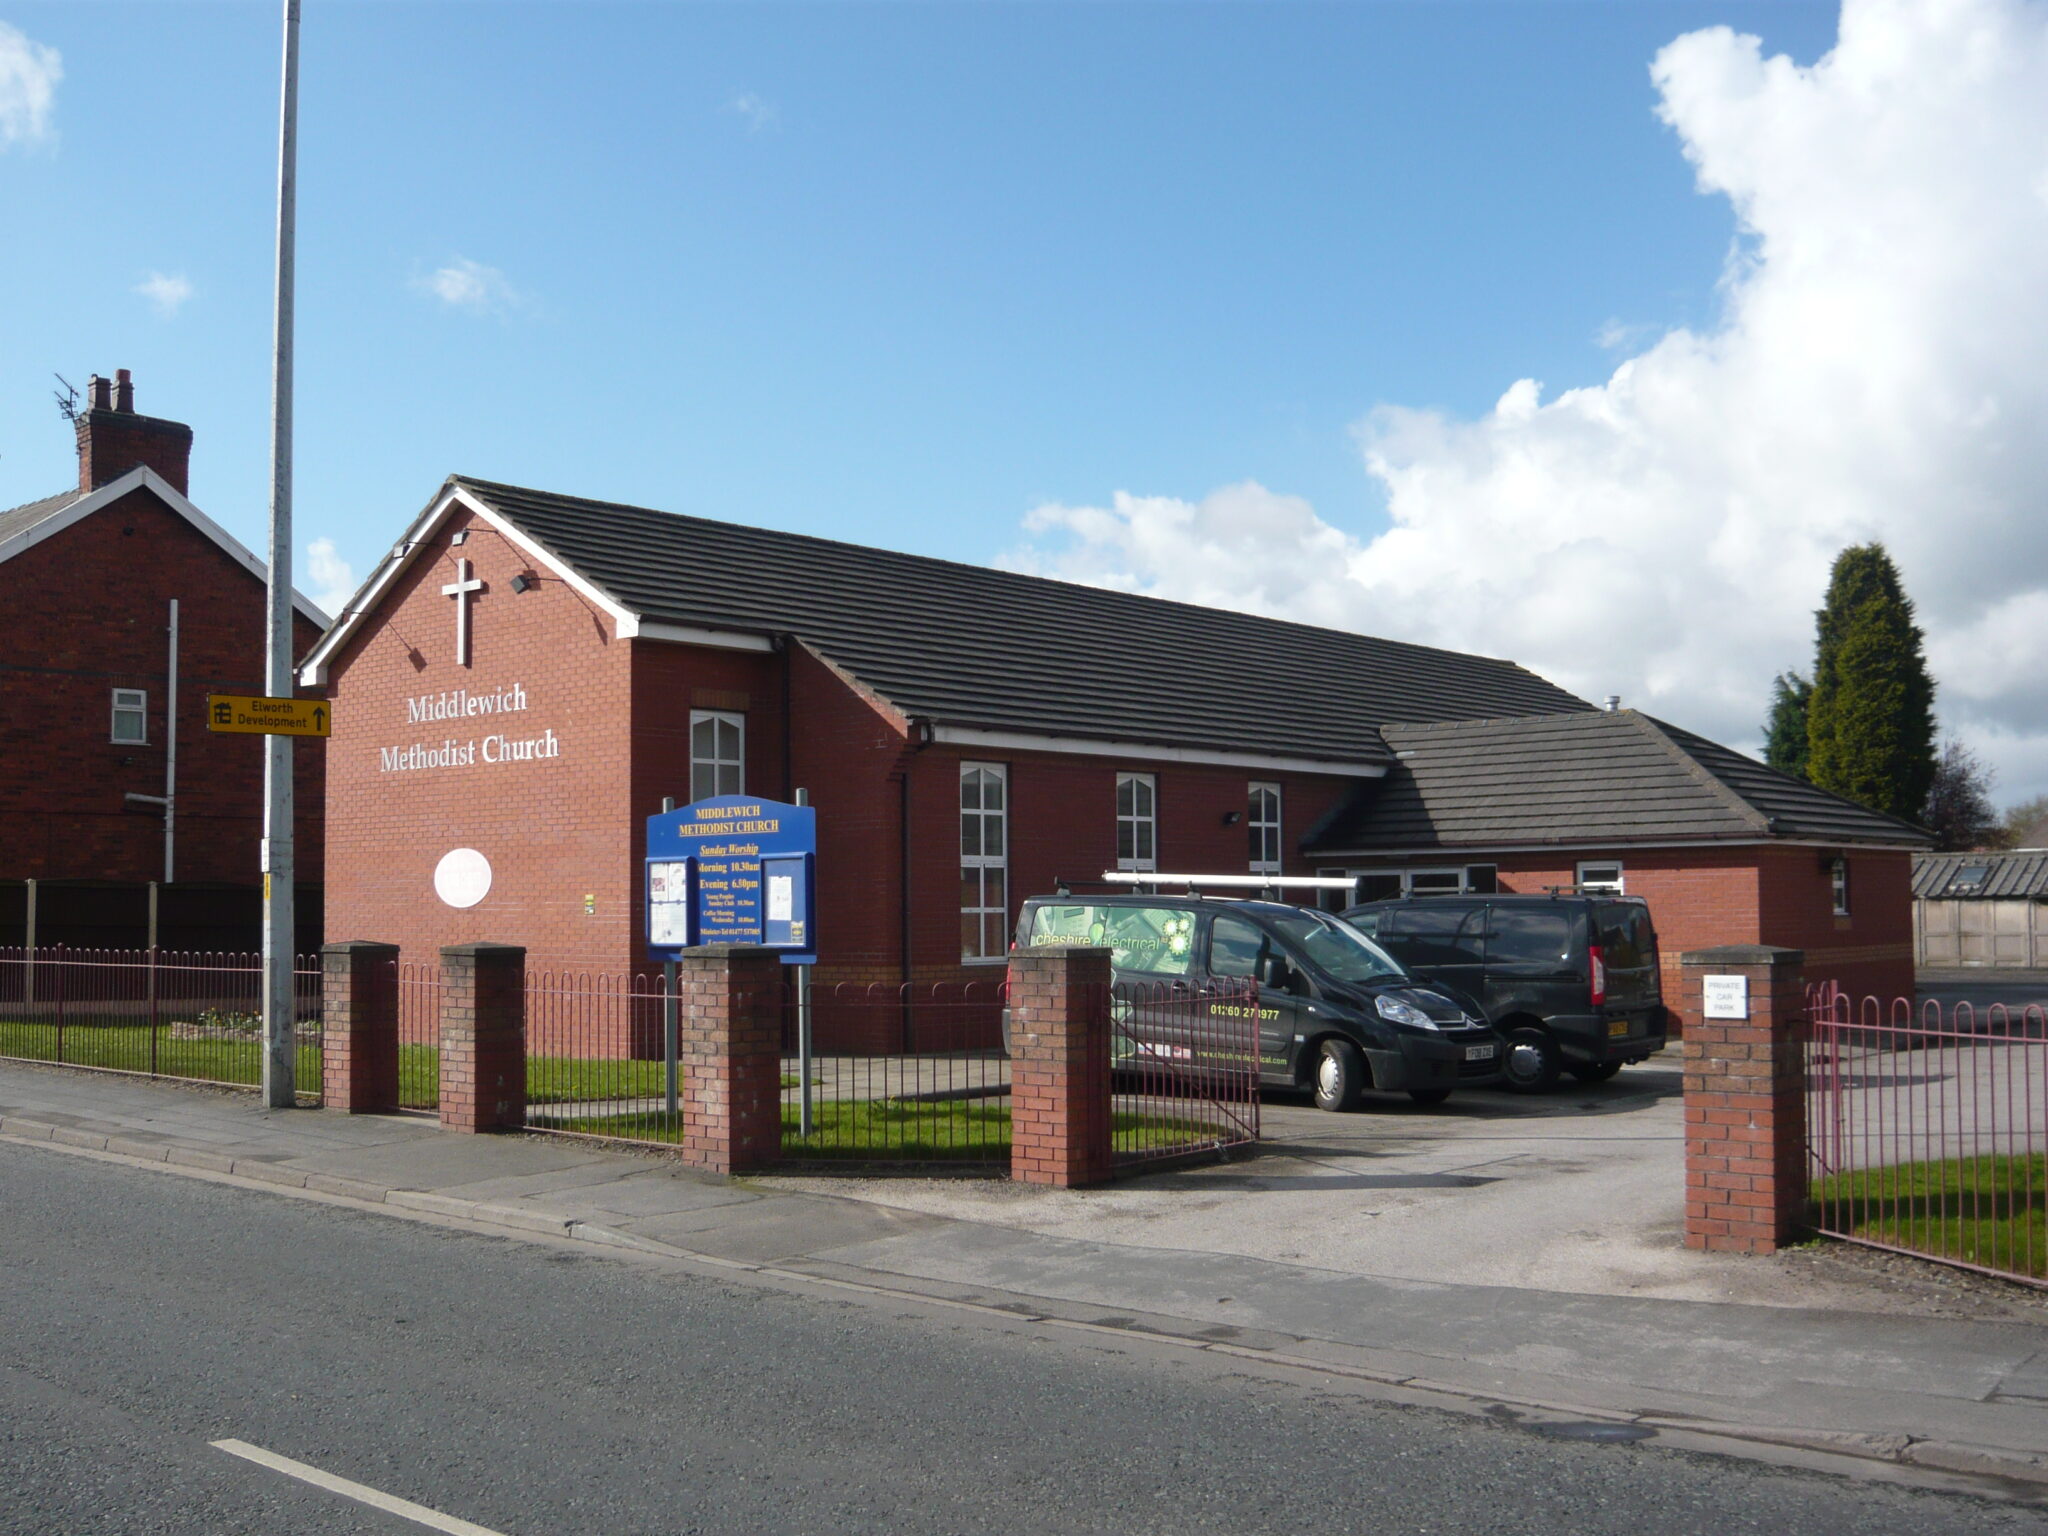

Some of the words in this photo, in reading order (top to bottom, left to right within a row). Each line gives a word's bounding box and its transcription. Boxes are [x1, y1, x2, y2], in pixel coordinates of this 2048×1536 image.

[252, 701, 293, 714] Elworth
[408, 683, 527, 724] Middlewich
[238, 714, 307, 728] Development
[380, 740, 475, 773] Methodist
[482, 728, 559, 763] Church
[696, 805, 760, 819] MIDDLEWICH
[679, 822, 735, 836] METHODIST
[736, 820, 779, 833] CHURCH
[700, 845, 726, 857] Sunday
[729, 843, 759, 855] Worship
[731, 862, 760, 872] 10.30am
[700, 879, 728, 891] Evening
[1036, 933, 1091, 947] cheshire
[1100, 935, 1160, 950] electrical
[1708, 982, 1741, 990] PRIVATE
[1210, 1004, 1240, 1016] 01260
